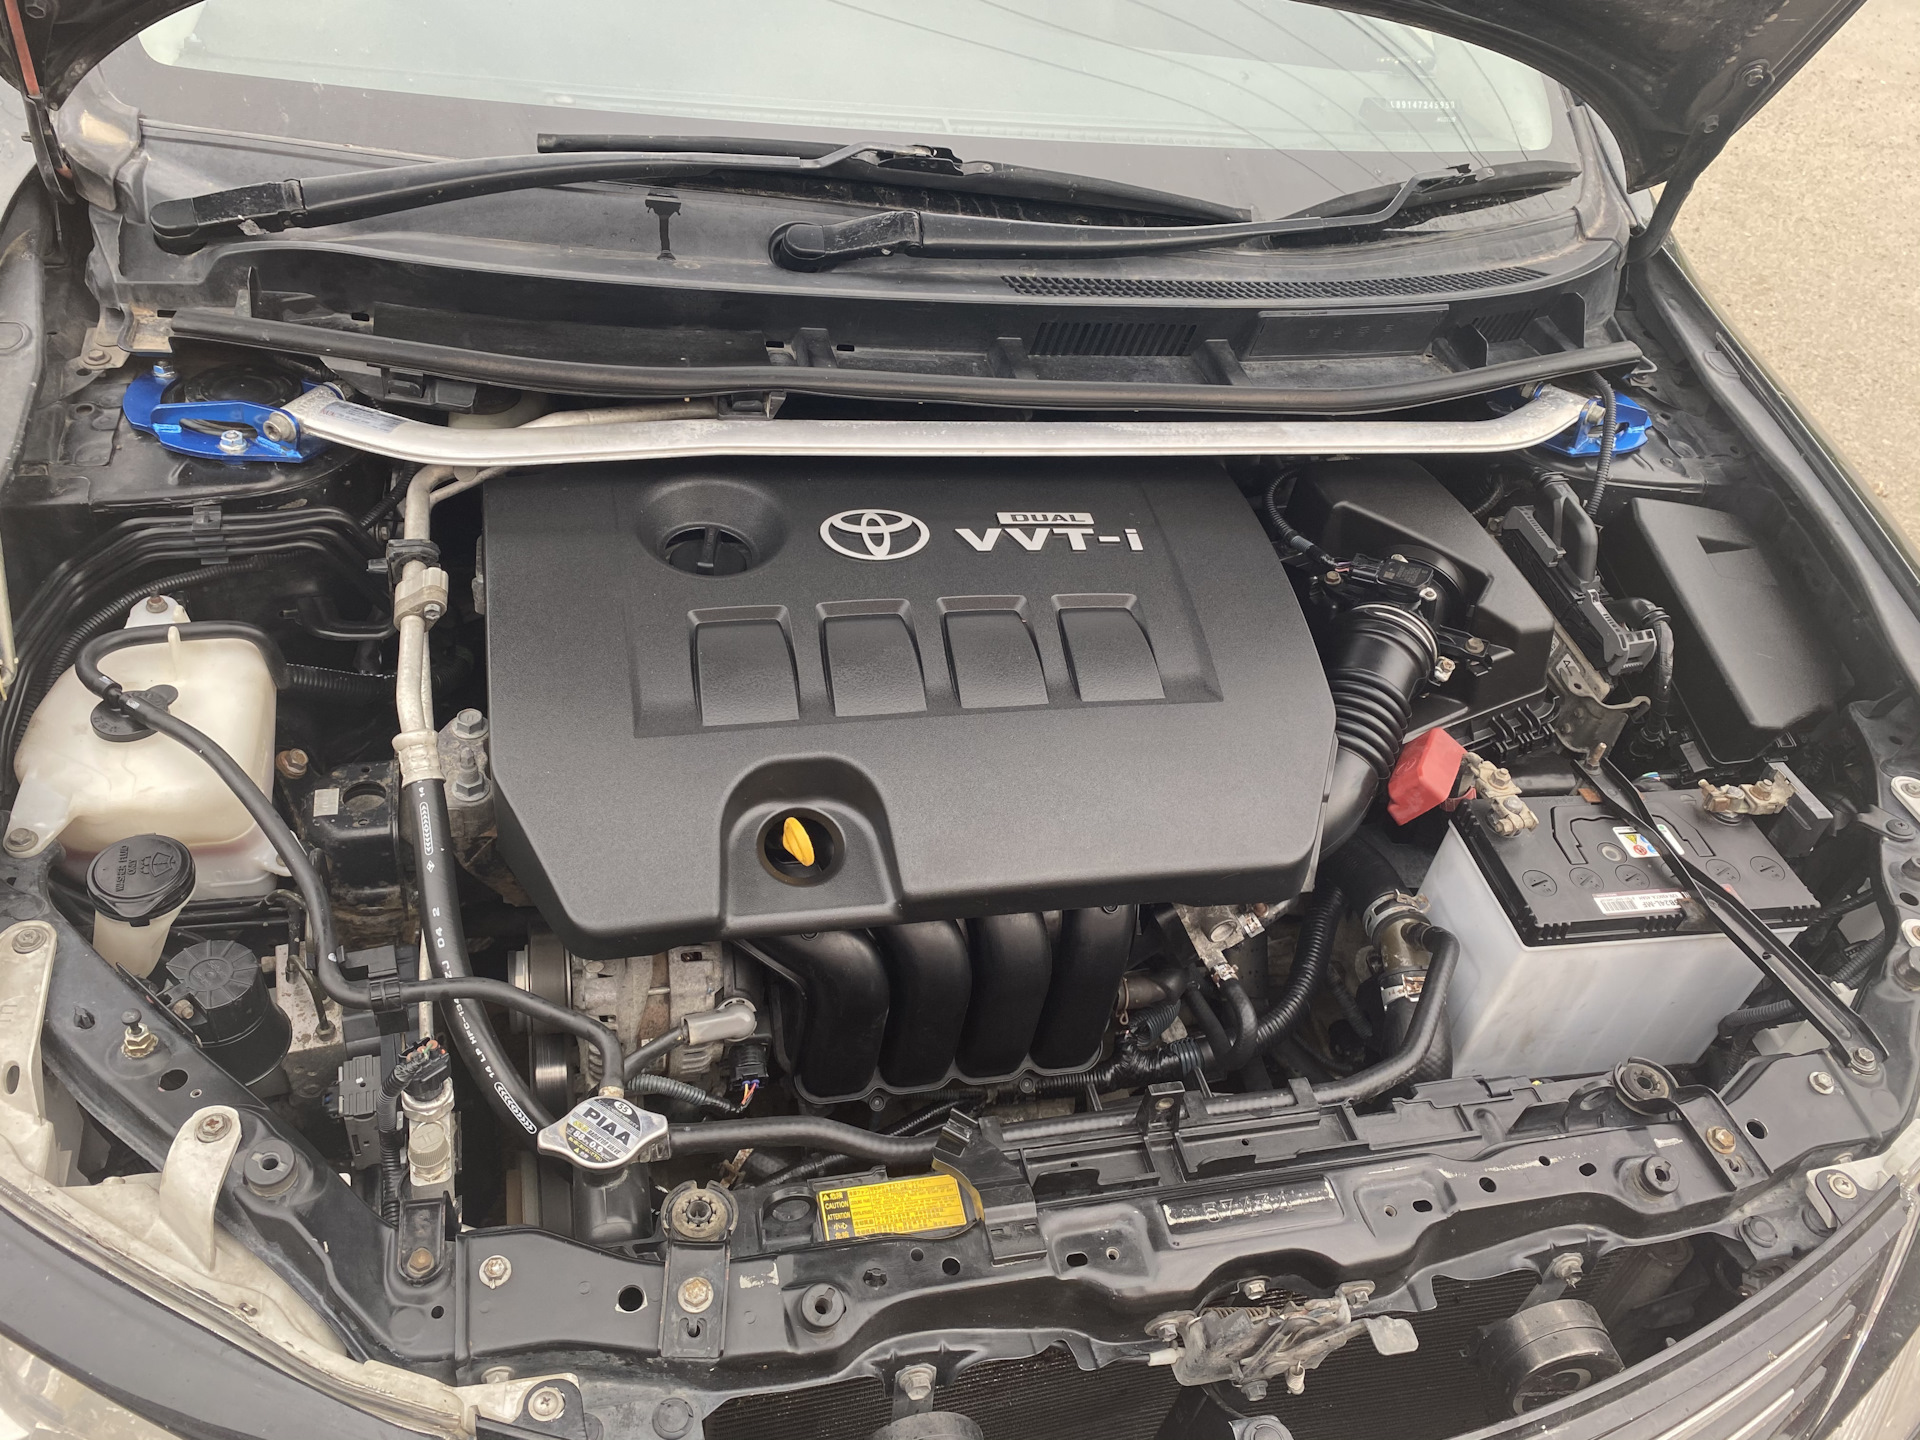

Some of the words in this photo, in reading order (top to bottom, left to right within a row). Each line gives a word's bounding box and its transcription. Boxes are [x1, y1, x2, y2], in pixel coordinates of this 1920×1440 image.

[1010, 513, 1086, 522] DUAL
[954, 528, 1144, 552] VVT-i
[418, 786, 426, 798] 14
[431, 907, 441, 918] 2
[474, 1047, 486, 1063] LP
[484, 1065, 496, 1079] 14
[617, 1102, 629, 1114] 55
[582, 1107, 632, 1146] PIAA
[824, 1200, 849, 1210] CAUTION
[827, 1211, 851, 1221] ATTENTION
[833, 1222, 848, 1231] 小心
